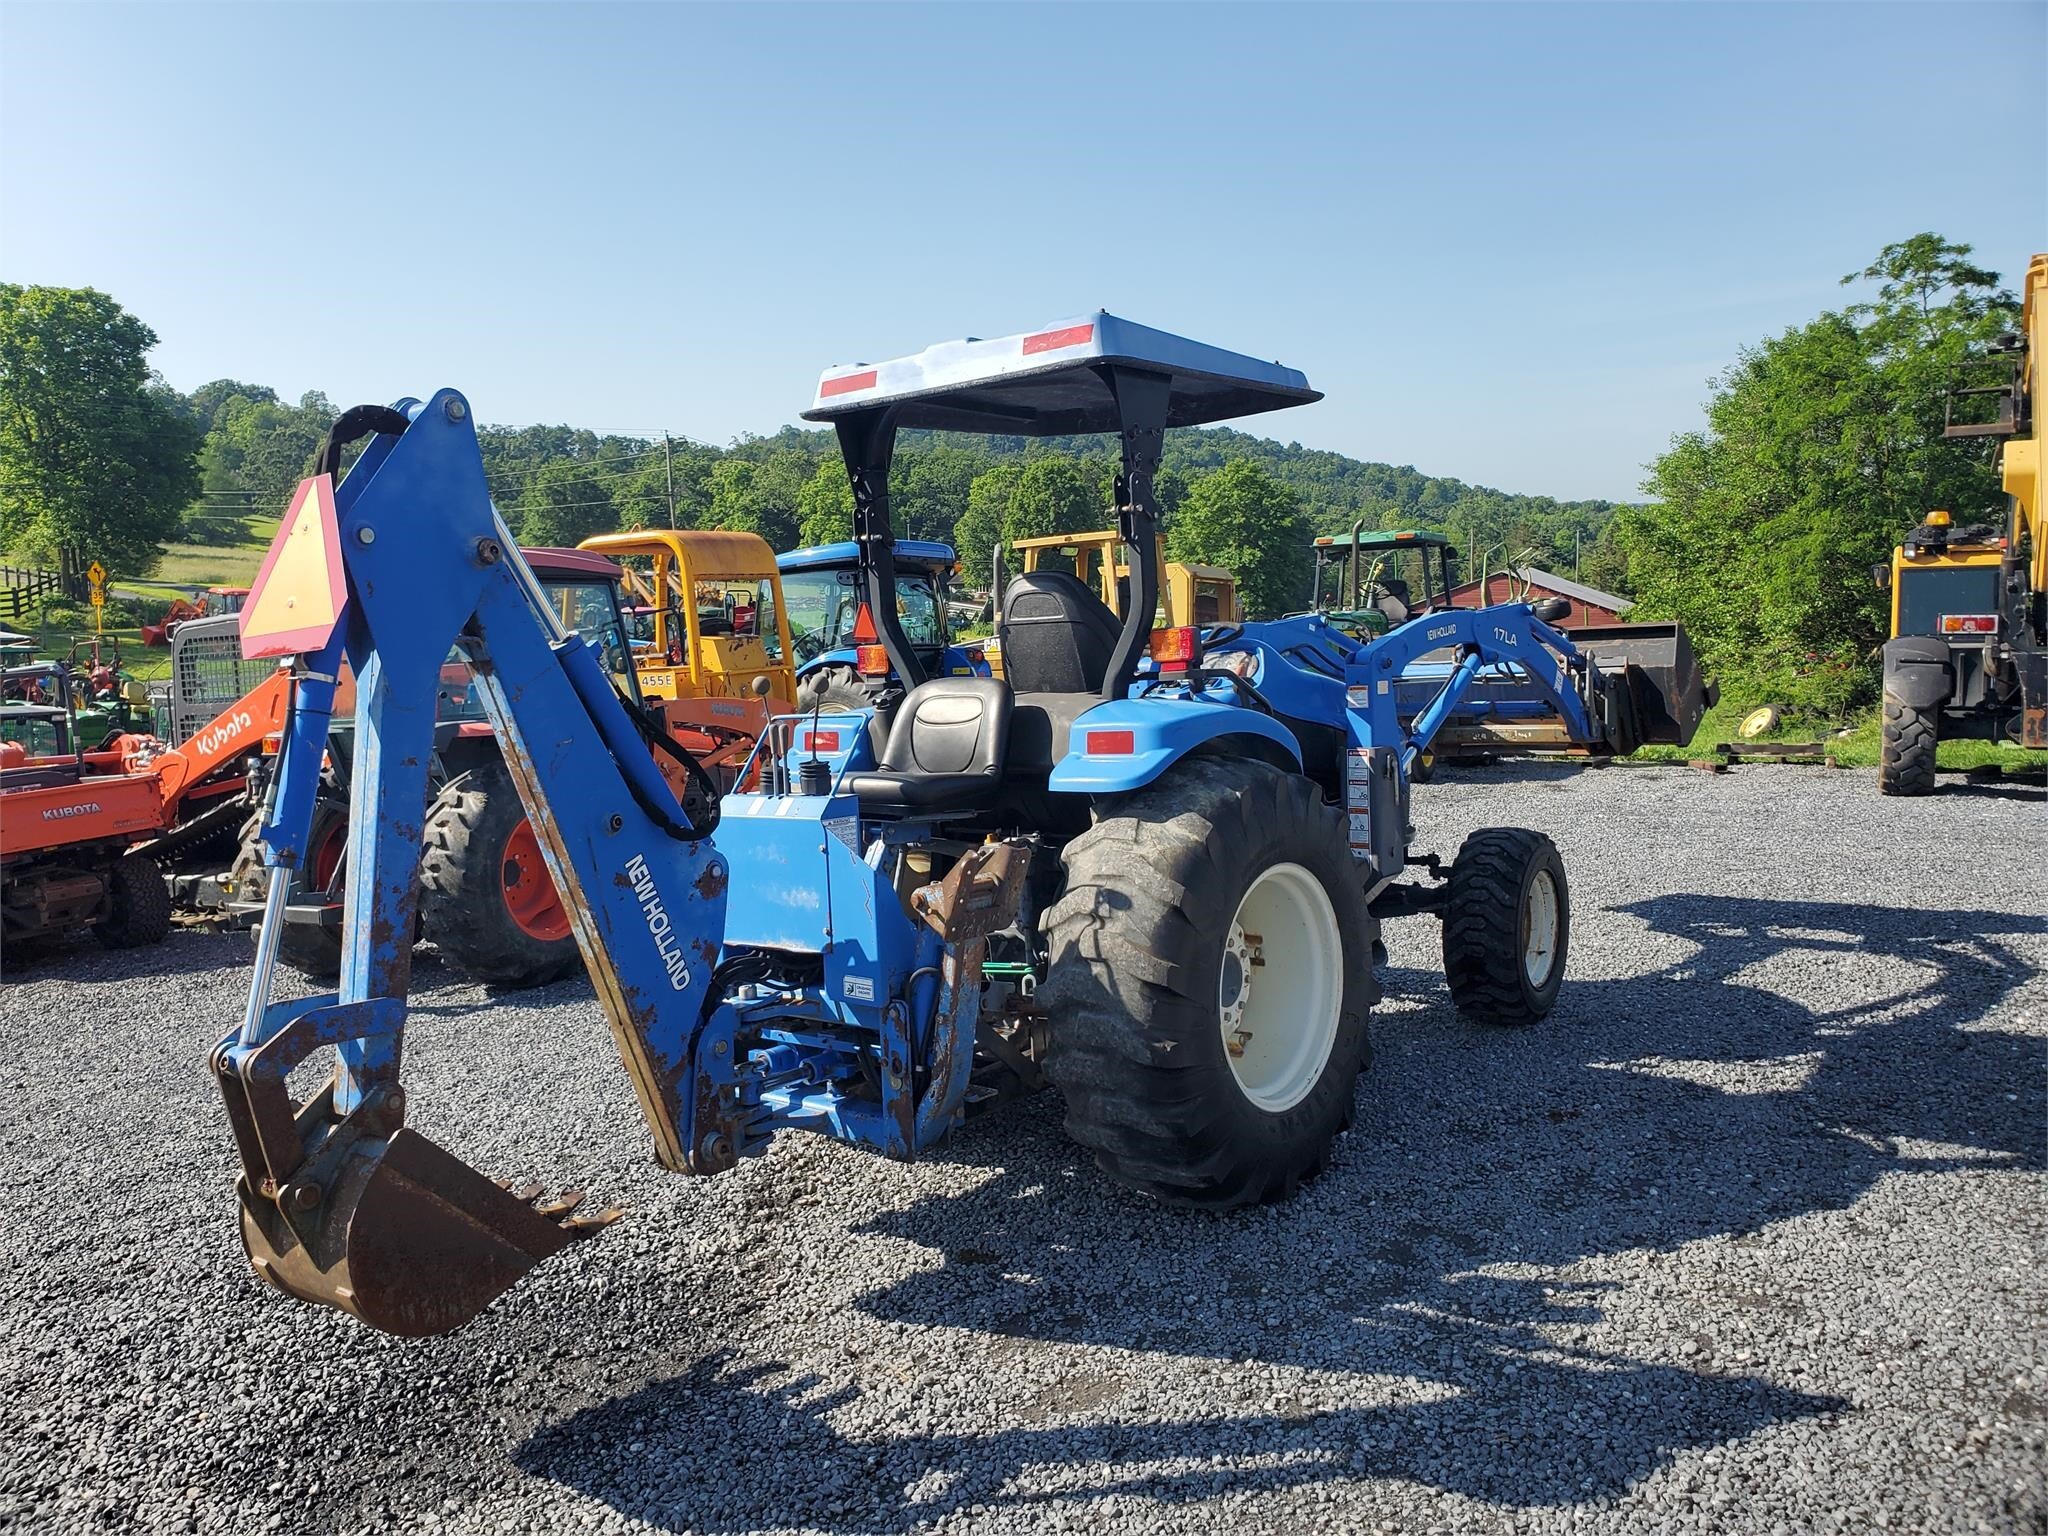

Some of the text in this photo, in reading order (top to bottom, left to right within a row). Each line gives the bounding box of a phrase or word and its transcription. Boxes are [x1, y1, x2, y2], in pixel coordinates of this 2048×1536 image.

[93, 591, 103, 600] 35
[1426, 629, 1437, 641] NEW
[1493, 627, 1518, 647] 17LA
[641, 674, 672, 687] 455E
[196, 711, 251, 756] Kubota
[42, 802, 102, 821] KUBOTA
[624, 853, 691, 991] NEW HOLLAND
